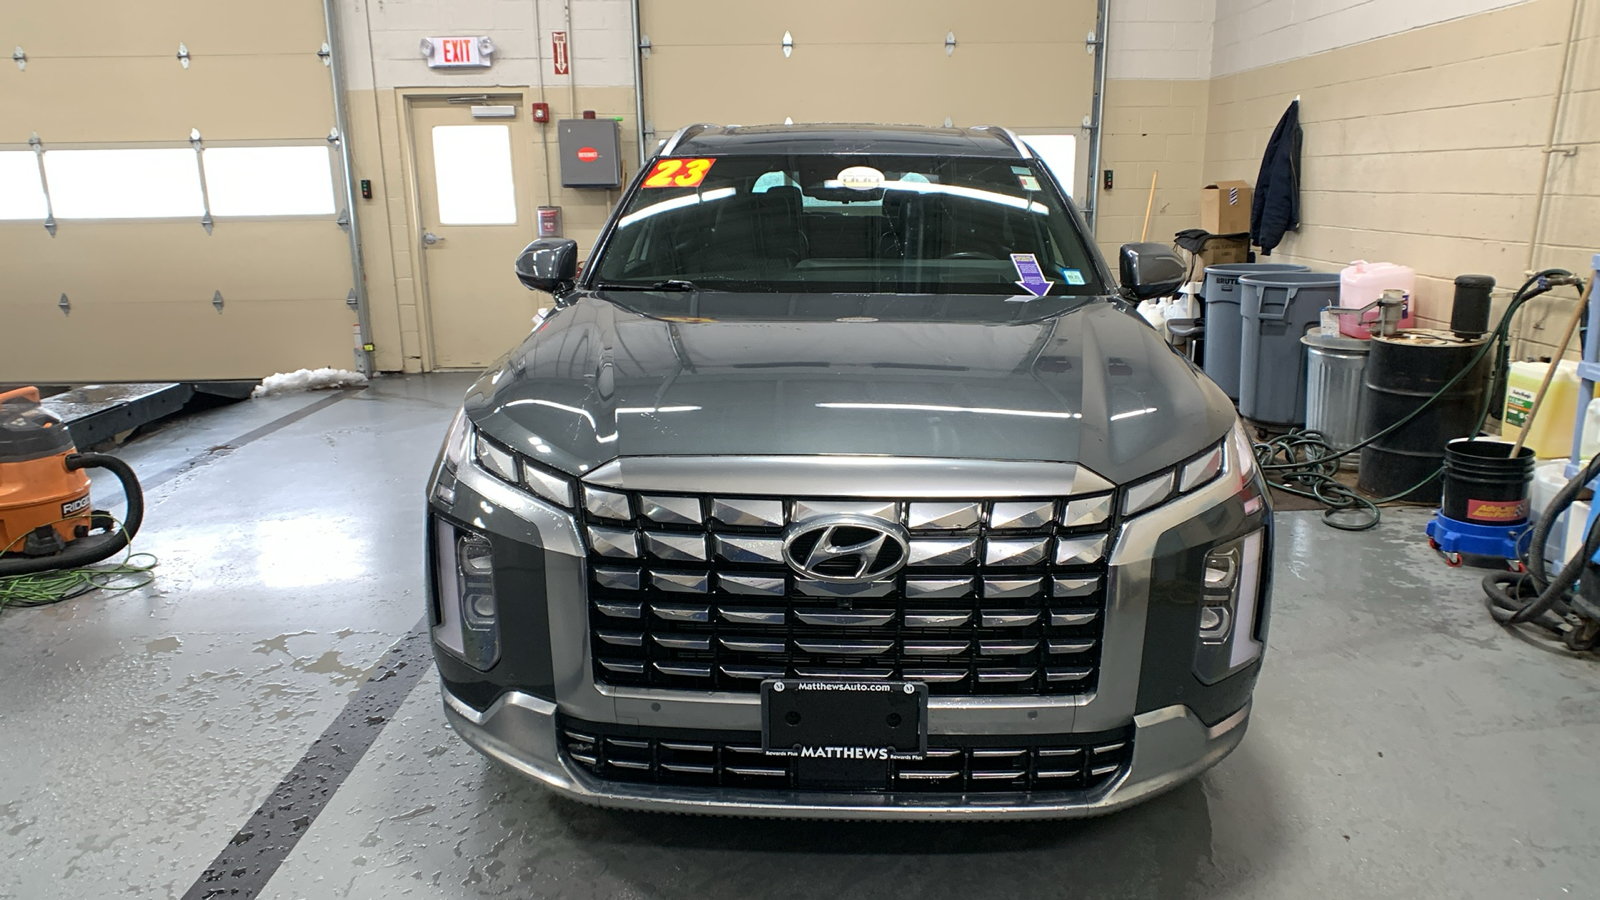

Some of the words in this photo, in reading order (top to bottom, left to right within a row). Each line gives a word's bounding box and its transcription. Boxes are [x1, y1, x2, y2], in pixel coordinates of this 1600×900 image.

[442, 39, 471, 63] EXIT
[645, 158, 710, 187] 23
[798, 682, 891, 692] MatthewsAuto.com
[800, 746, 888, 760] MATTHEWS
